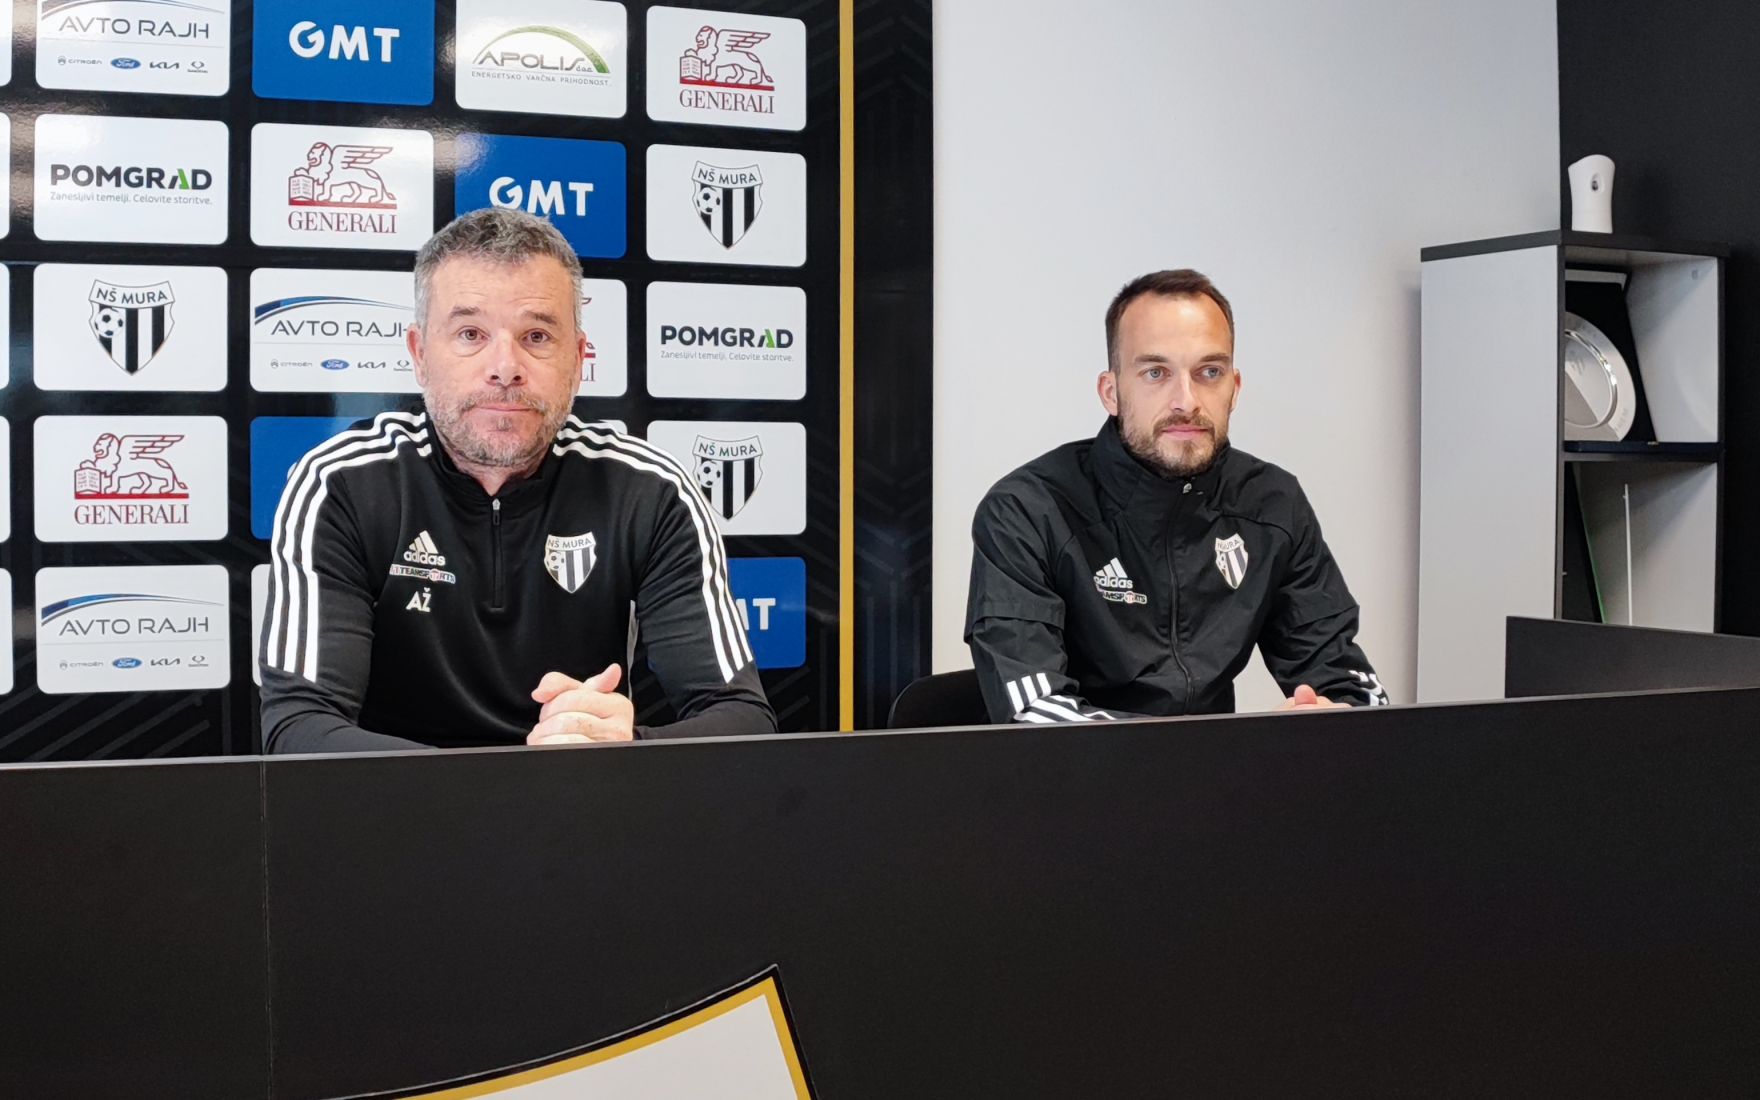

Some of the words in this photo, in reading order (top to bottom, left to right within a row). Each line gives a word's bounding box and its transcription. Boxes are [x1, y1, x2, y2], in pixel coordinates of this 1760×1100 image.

[59, 16, 131, 34] AVTO
[138, 19, 209, 39] RAJH
[289, 20, 400, 63] GMT
[478, 50, 585, 72] APOLIS
[471, 71, 522, 81] ENERGETSKO
[526, 73, 556, 82] VARČNA
[679, 89, 775, 114] GENERALI
[51, 164, 213, 190] POMGRAD
[697, 168, 715, 183] NŠ
[718, 172, 758, 185] MURA
[50, 191, 95, 202] Zanesljivi
[133, 193, 172, 204] Celovite
[489, 176, 594, 217] GMT
[288, 211, 397, 234] GENERALI
[96, 288, 117, 302] NŠ
[121, 290, 168, 305] MURA
[271, 320, 339, 337] AVTO
[661, 325, 794, 349] POMGRAD
[728, 352, 761, 361] Celovite
[698, 442, 715, 456] NŠ
[718, 444, 757, 457] MURA
[74, 504, 189, 525] GENERALI
[562, 538, 592, 549] MURA
[403, 549, 446, 567] adidas
[1093, 575, 1134, 589] adidas
[406, 586, 432, 613] AŽ
[59, 619, 131, 636] AVTO
[138, 616, 209, 634] RAJH
